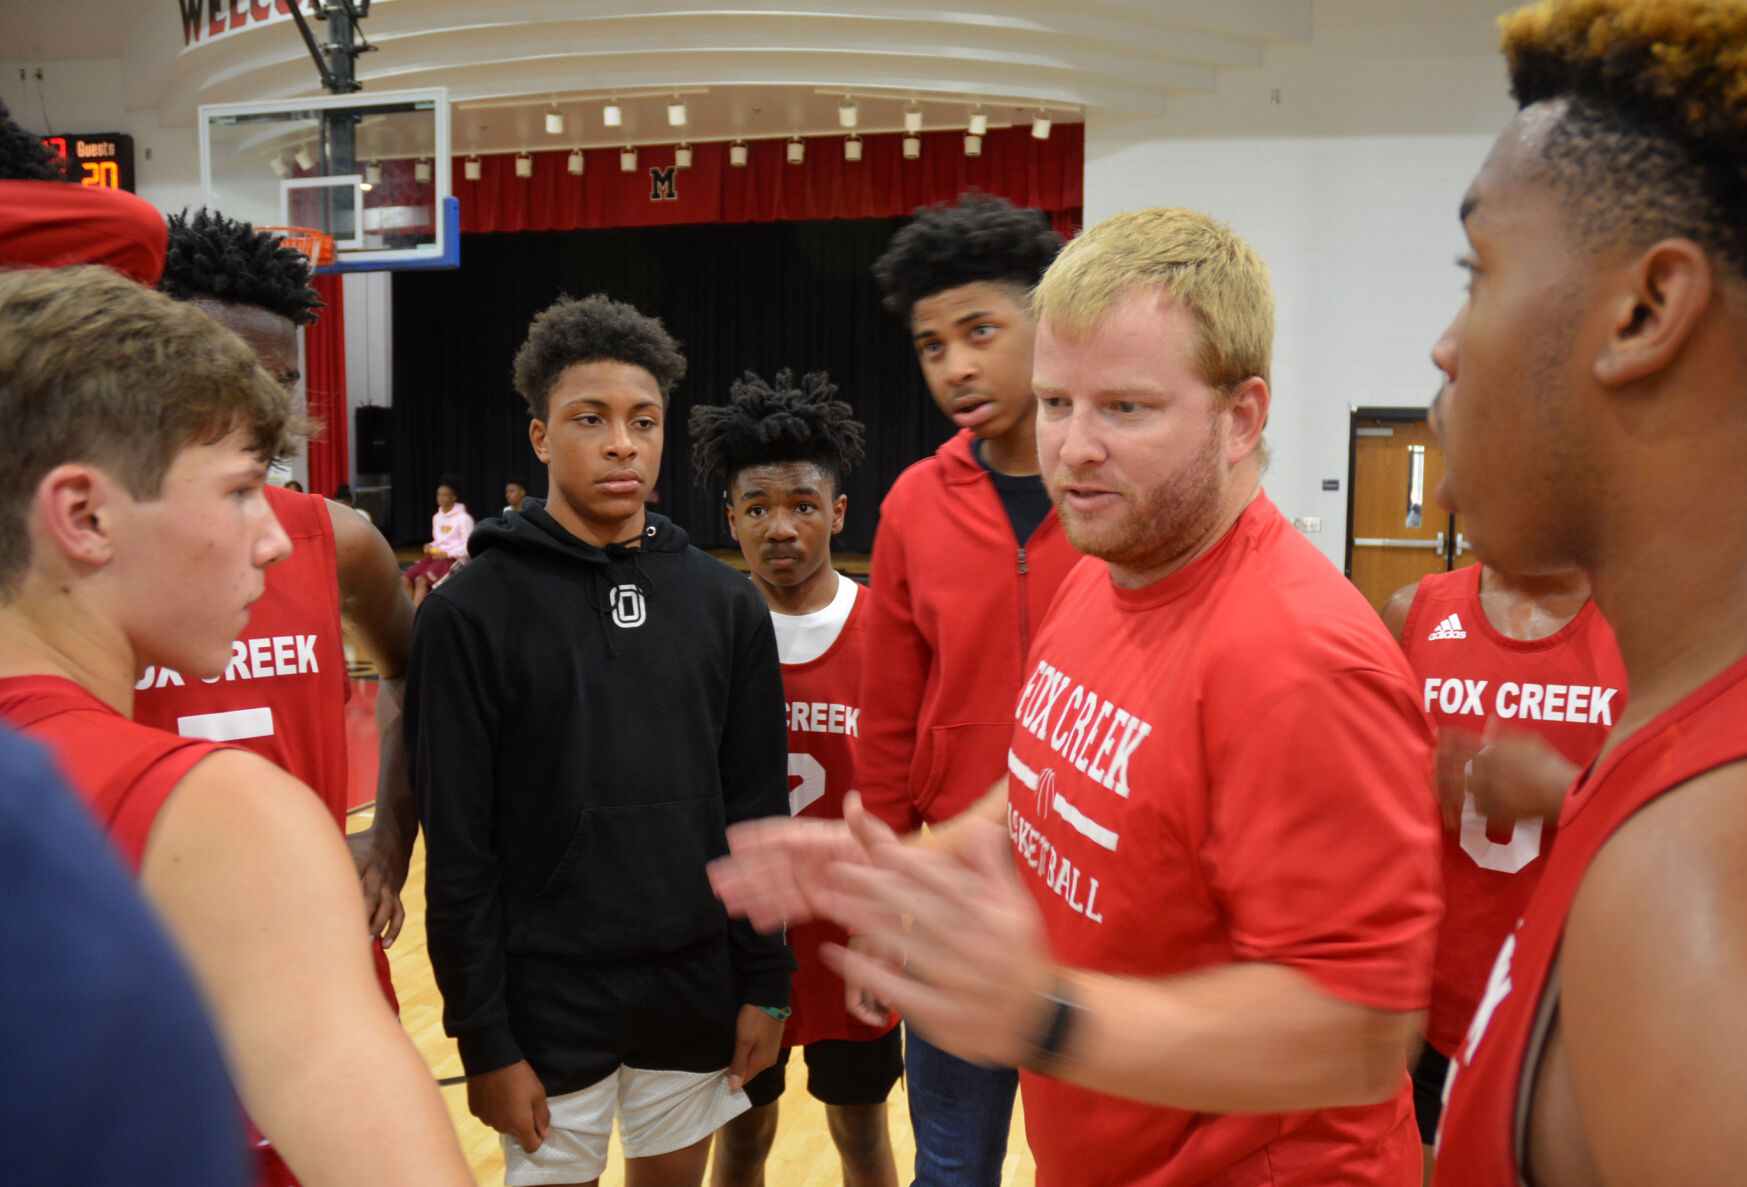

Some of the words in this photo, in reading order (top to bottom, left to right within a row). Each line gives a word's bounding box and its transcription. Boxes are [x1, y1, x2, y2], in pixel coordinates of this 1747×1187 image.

[76, 141, 116, 157] Guests
[650, 166, 678, 200] M
[1428, 630, 1467, 640] adidas
[201, 634, 319, 683] REEK
[1425, 678, 1488, 716] FOX
[1495, 682, 1618, 726] CREEK
[1015, 660, 1072, 741] FOX
[1051, 684, 1152, 799] CREEK
